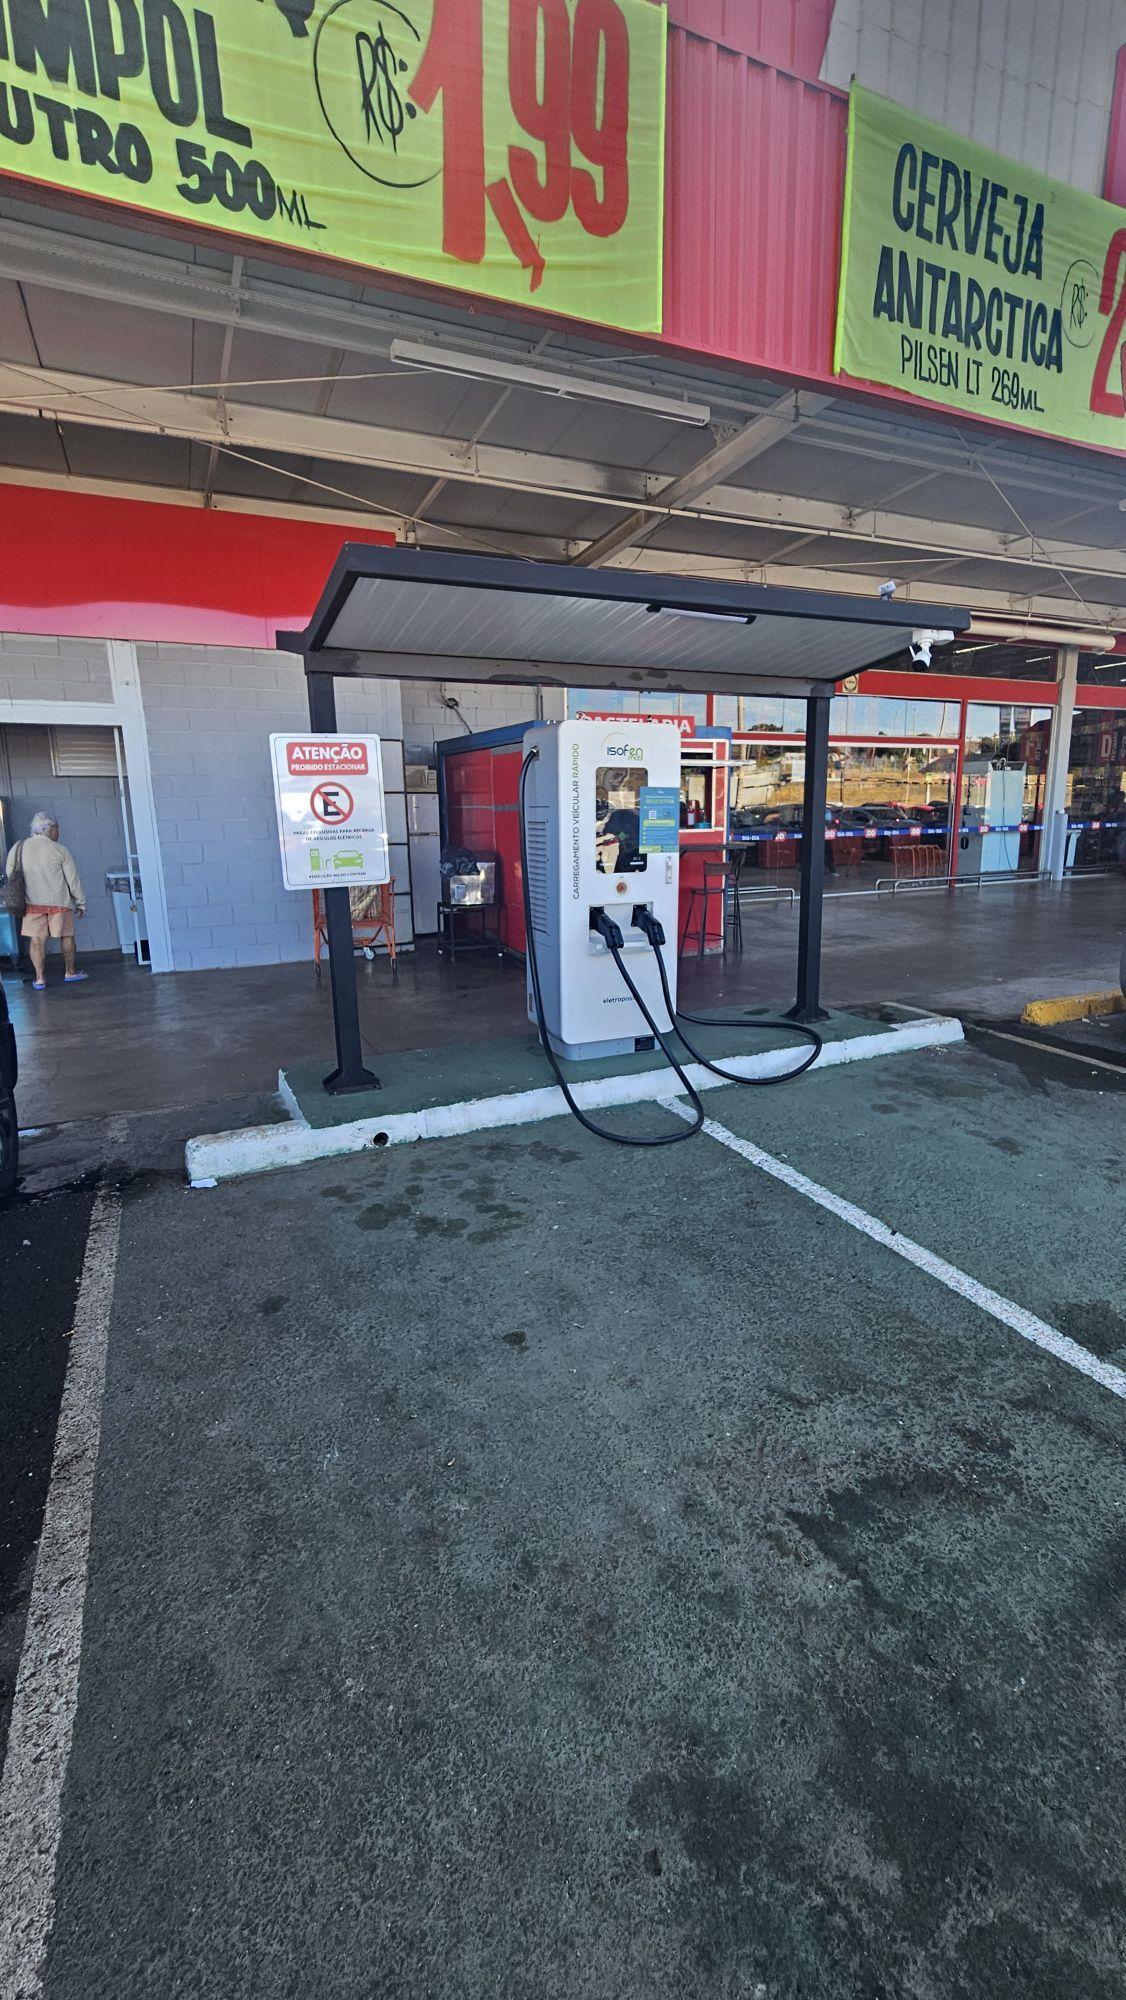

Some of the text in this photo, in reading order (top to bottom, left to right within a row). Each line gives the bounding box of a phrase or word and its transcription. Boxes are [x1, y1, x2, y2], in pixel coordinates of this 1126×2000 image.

[892, 142, 1045, 281] CERVEJA
[872, 244, 1064, 374] ANTARCTICA
[900, 334, 960, 390] PILSEN
[965, 357, 984, 396] LT
[290, 763, 366, 771] PROIBIDO ESTACIONAR
[292, 743, 363, 764] ATENÇÃO
[572, 826, 580, 900] CARREGAMENTO
